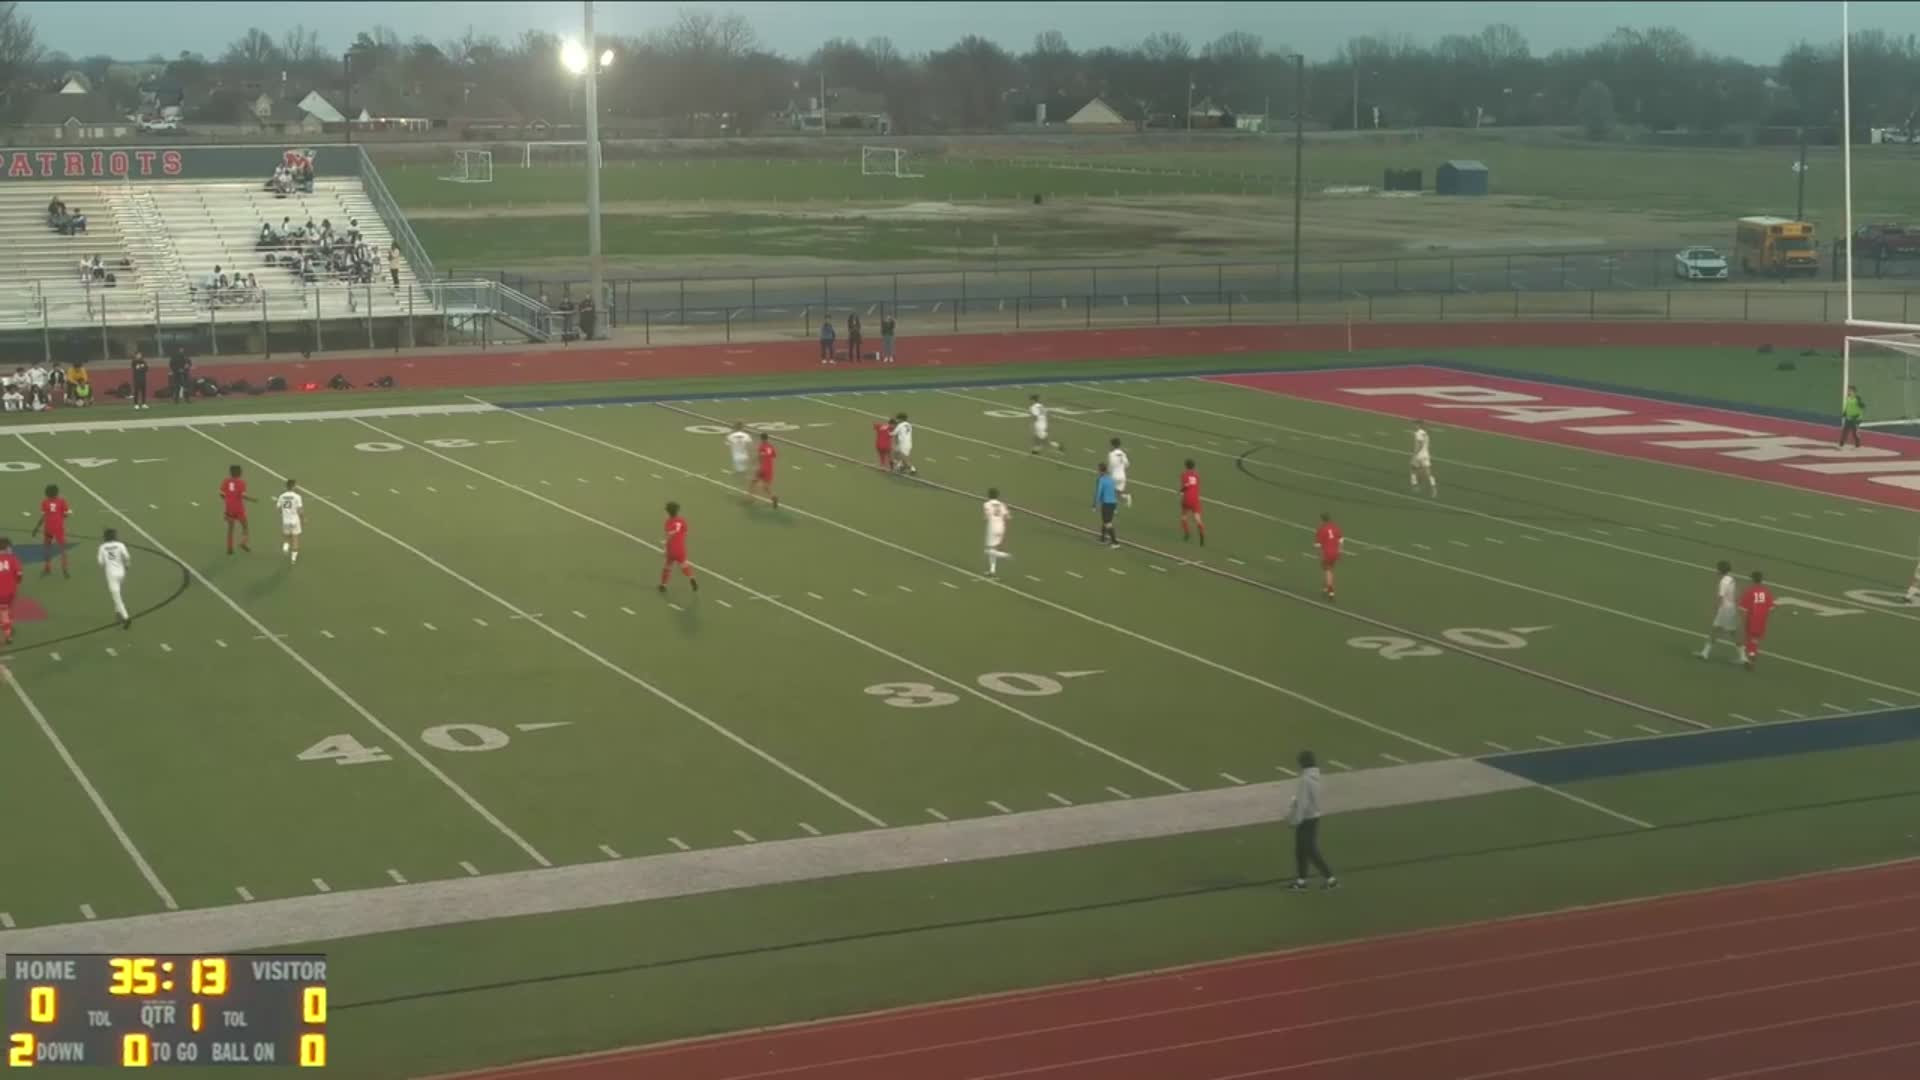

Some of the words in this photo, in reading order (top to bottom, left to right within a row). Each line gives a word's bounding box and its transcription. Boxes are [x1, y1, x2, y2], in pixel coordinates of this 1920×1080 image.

[0, 151, 183, 177] ATRIOTS
[1336, 384, 1920, 491] PATRI
[1345, 627, 1529, 661] 20
[863, 671, 1064, 708] 30
[295, 723, 511, 766] 40
